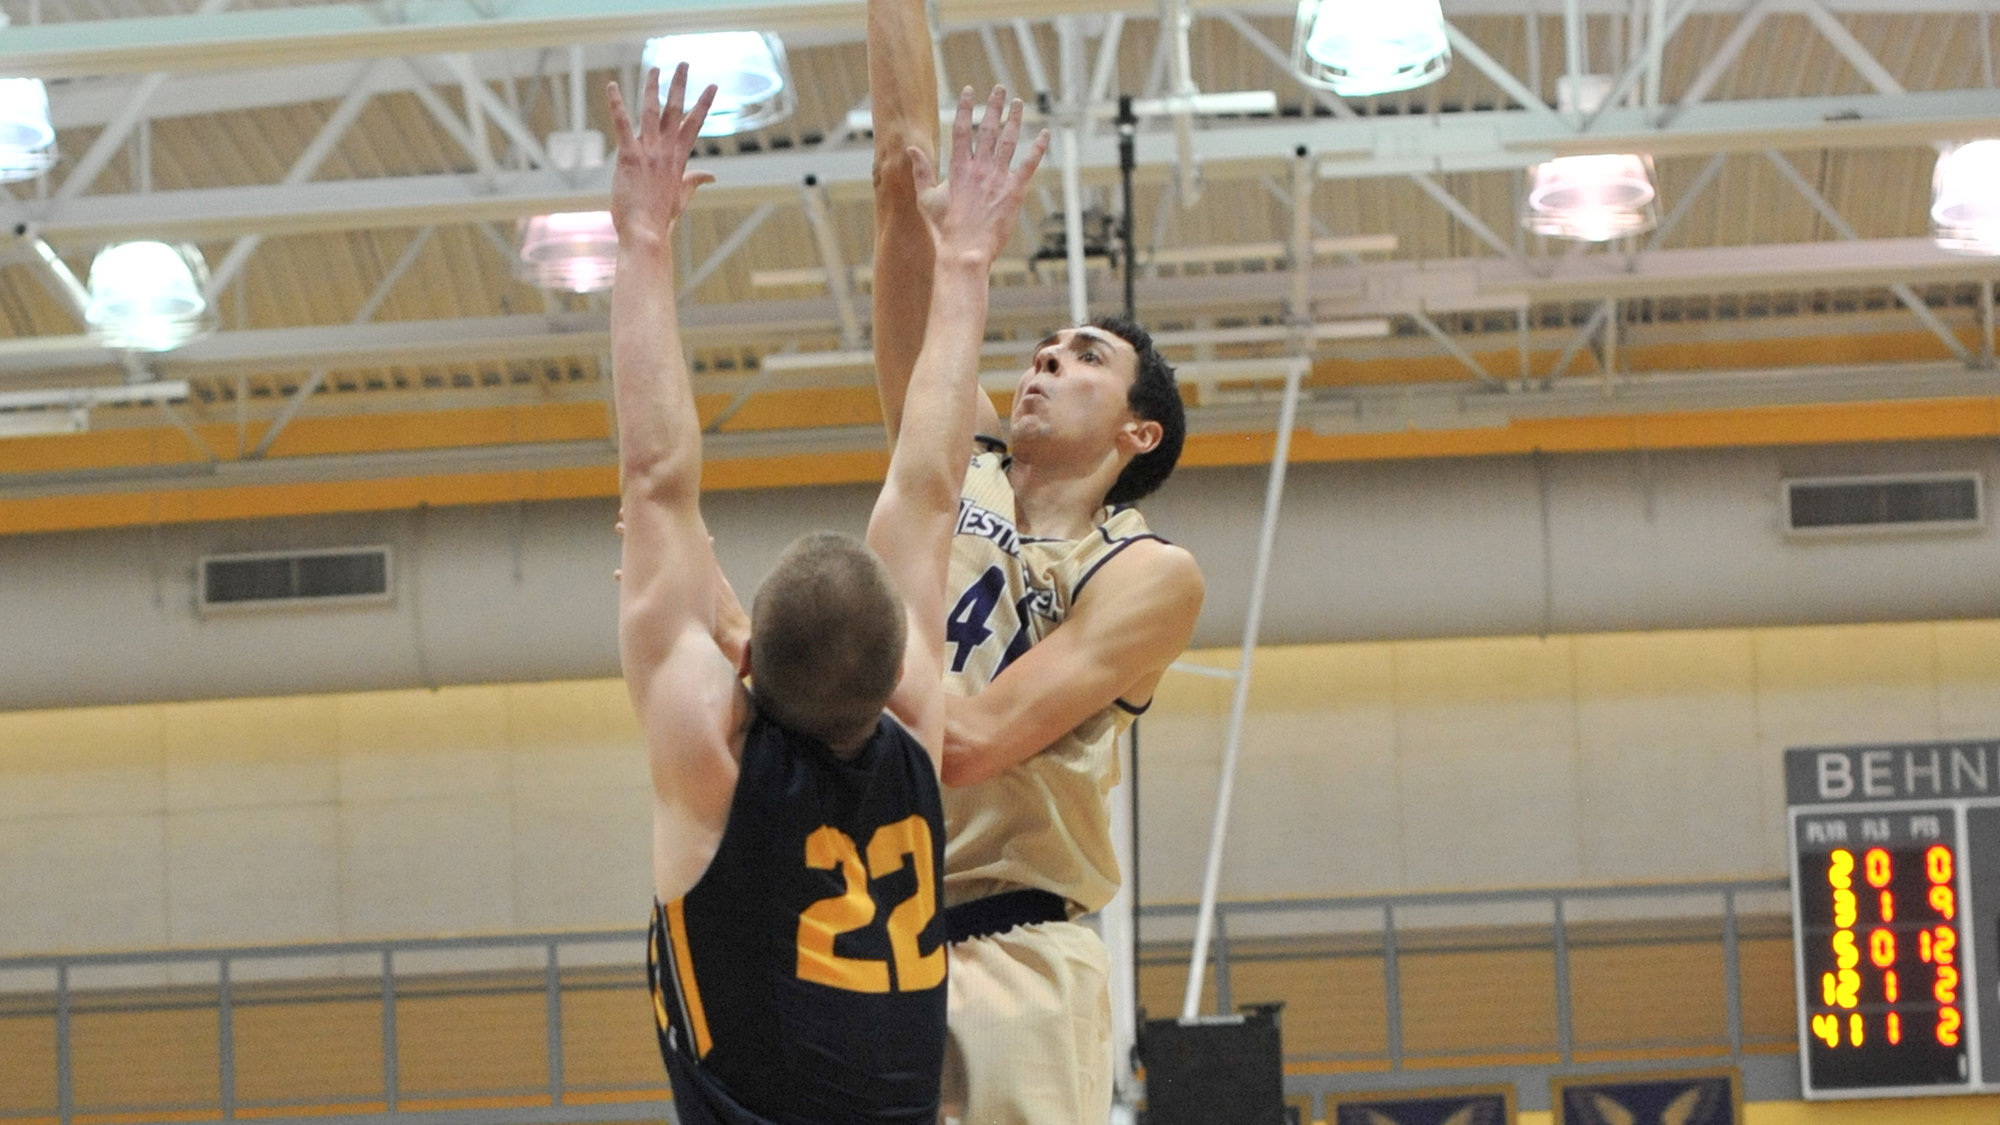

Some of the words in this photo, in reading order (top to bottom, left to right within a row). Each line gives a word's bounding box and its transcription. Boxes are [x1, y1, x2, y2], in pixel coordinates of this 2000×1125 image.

[1816, 746, 2000, 799] BEHN
[1909, 815, 1940, 839] PTS
[1828, 848, 1854, 889] 2
[1864, 847, 1892, 889] 0
[1926, 845, 1953, 885] 0
[796, 814, 947, 993] 22
[1833, 889, 1857, 929] 3
[1879, 889, 1894, 923] 1
[1928, 885, 1955, 921] 9
[1832, 929, 1860, 969] 5
[1869, 928, 1896, 968] 0
[1919, 925, 1957, 965] 12
[1822, 968, 1861, 1009] 12
[1884, 969, 1898, 1003] 1
[1933, 964, 1959, 1005] 2
[1886, 1010, 1901, 1046] 1
[1935, 1005, 1962, 1047] 2
